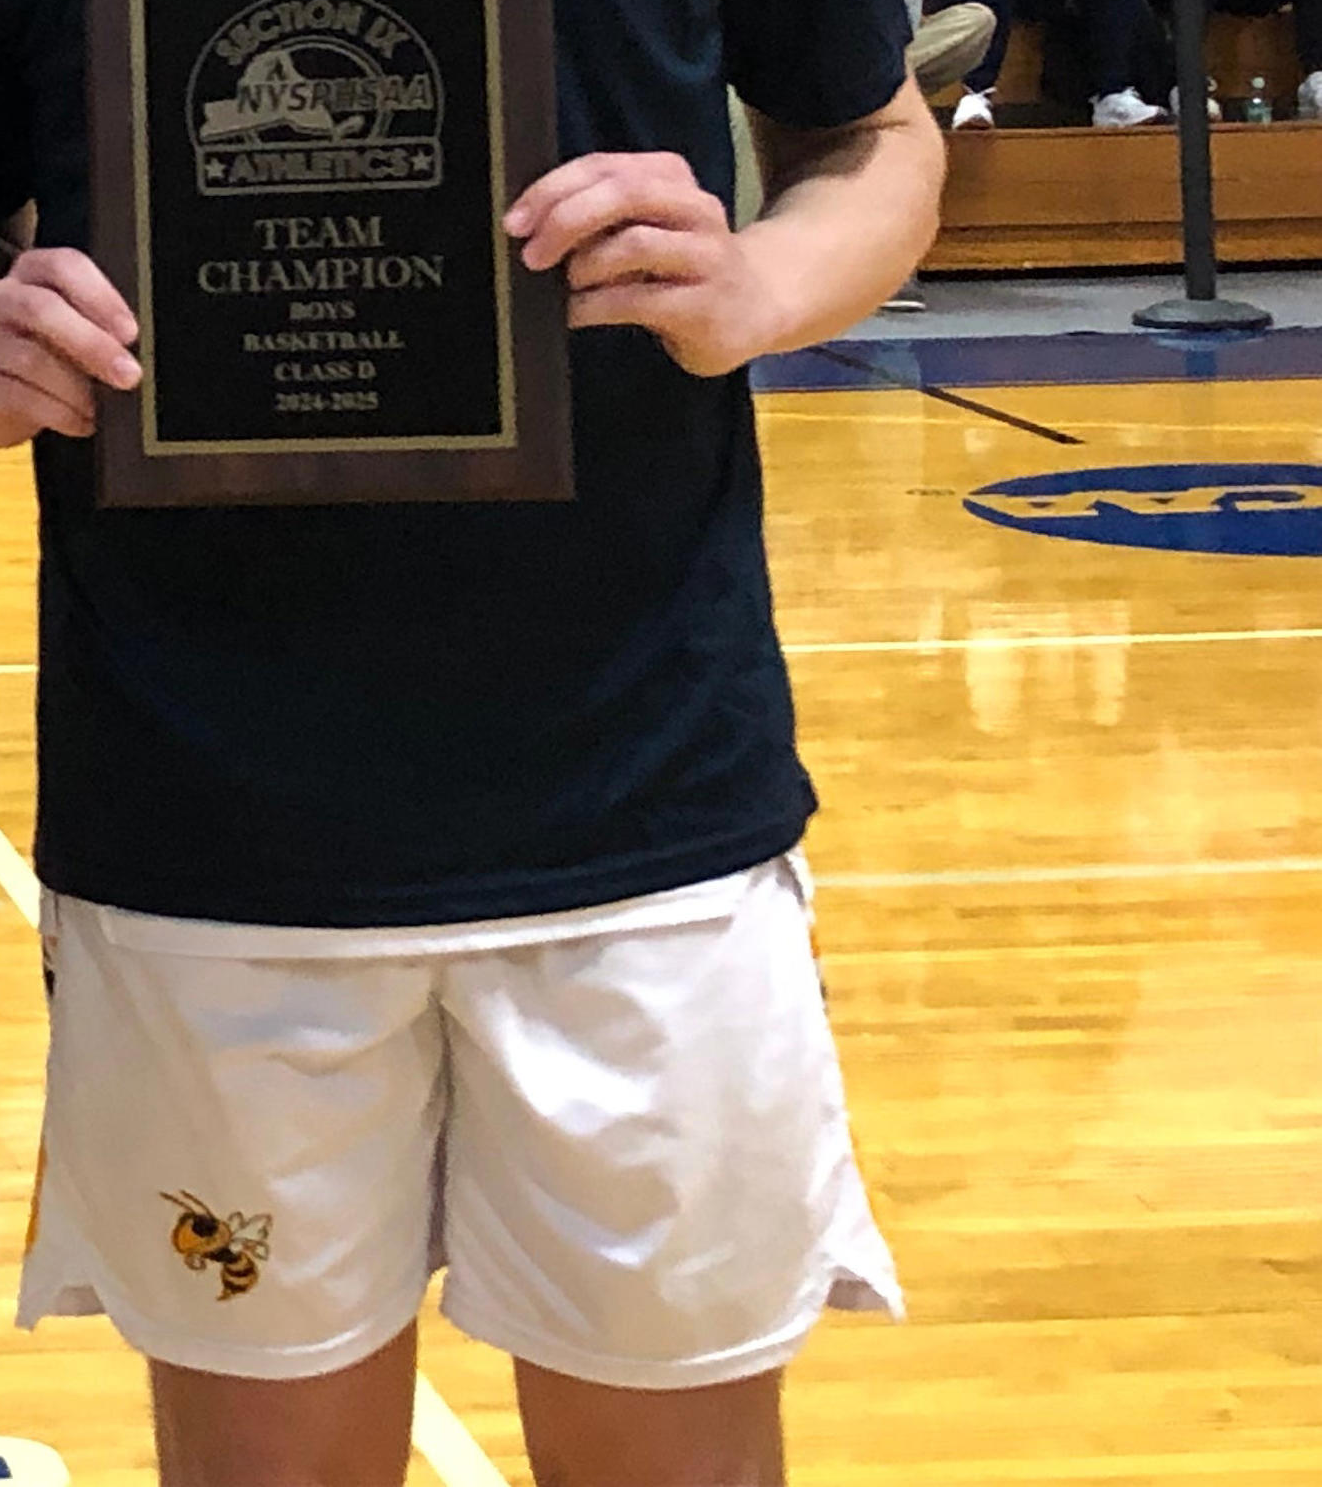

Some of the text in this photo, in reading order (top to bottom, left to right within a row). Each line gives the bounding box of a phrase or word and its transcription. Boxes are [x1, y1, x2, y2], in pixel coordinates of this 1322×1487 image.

[237, 73, 435, 114] NYSPHSAA
[228, 148, 409, 183] ATHLETICS
[254, 216, 385, 251] TEAM
[197, 255, 444, 294] CHAMPION
[289, 300, 357, 321] BOYS
[242, 330, 406, 352] BASKETBALL
[273, 360, 378, 382] CLASS D
